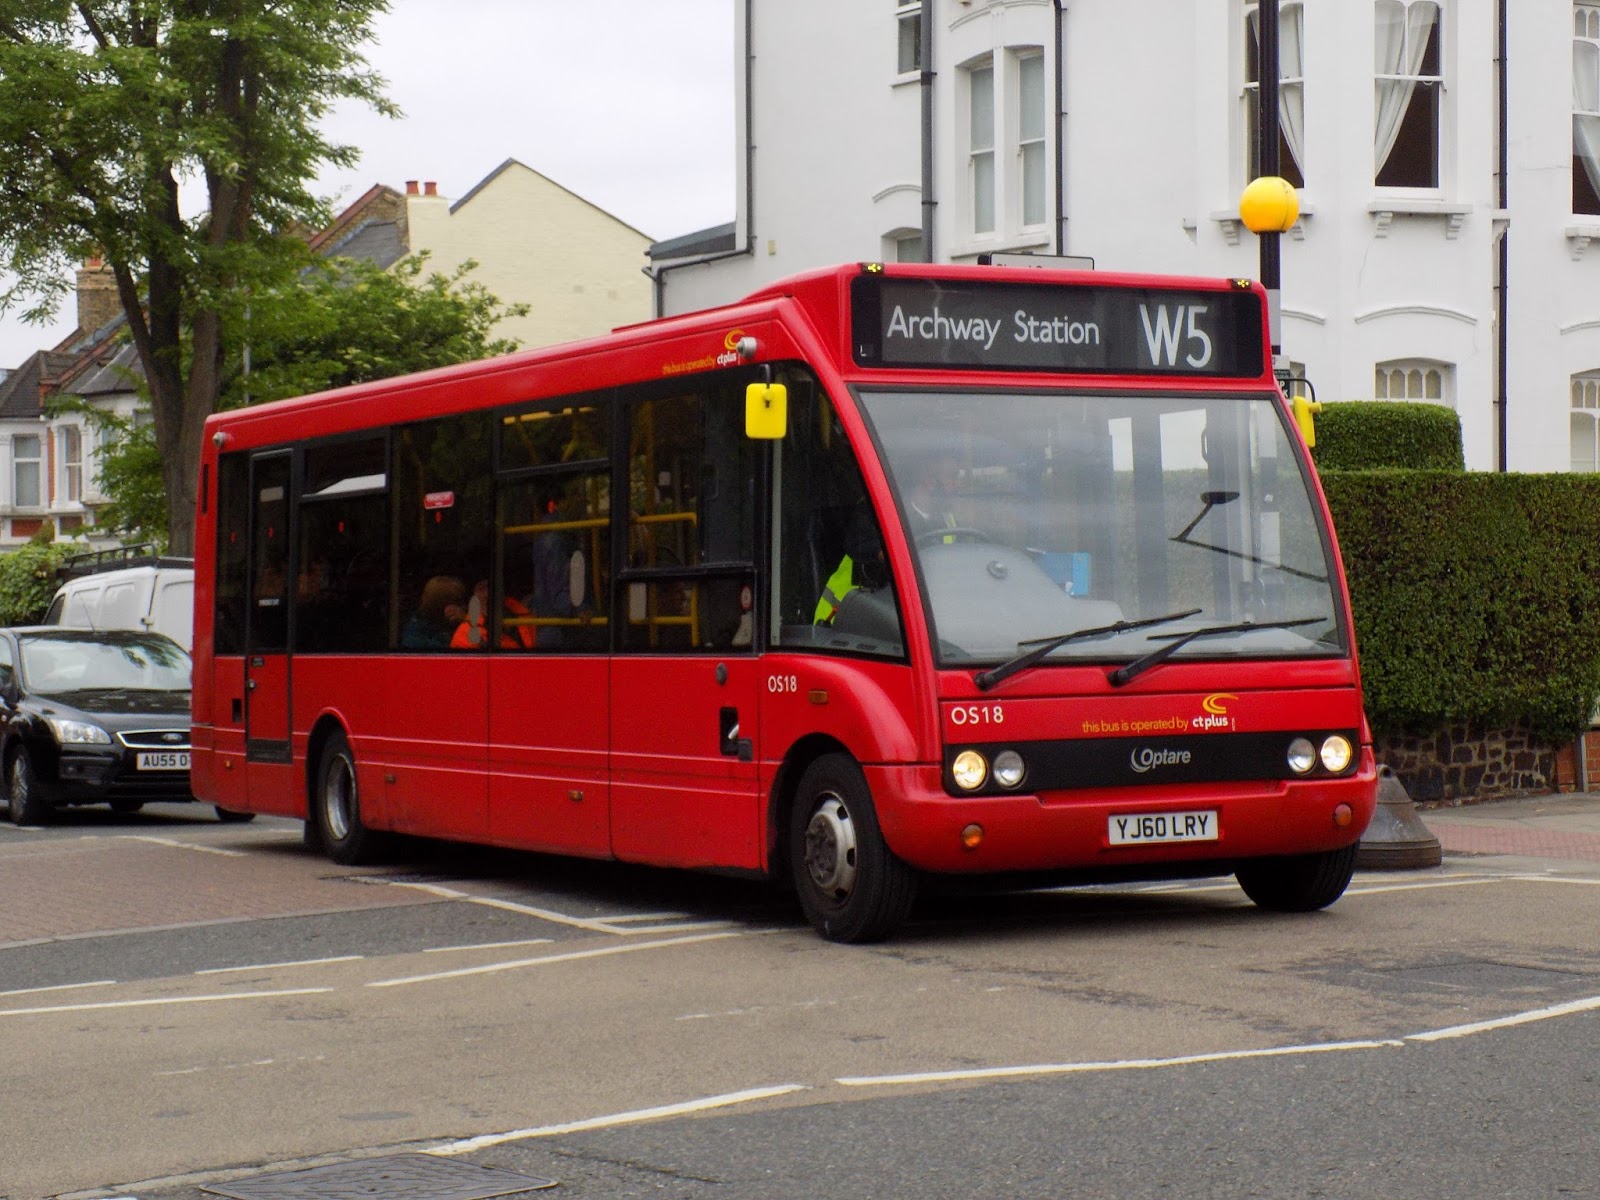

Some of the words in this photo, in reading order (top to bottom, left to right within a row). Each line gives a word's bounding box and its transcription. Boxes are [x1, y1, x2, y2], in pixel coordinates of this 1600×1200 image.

[886, 305, 1001, 350] Archway
[1014, 309, 1100, 345] Station
[1139, 304, 1212, 368] W5
[767, 675, 797, 693] OS18
[951, 706, 1004, 725] OS18
[1082, 720, 1100, 733] this
[1101, 719, 1119, 732] bus
[1121, 719, 1129, 731] is
[1131, 716, 1175, 733] operated
[1176, 716, 1189, 731] by
[143, 754, 176, 767] AU55
[1138, 748, 1191, 769] Optare
[1117, 816, 1167, 840] YJ60
[1172, 815, 1208, 836] LRY
